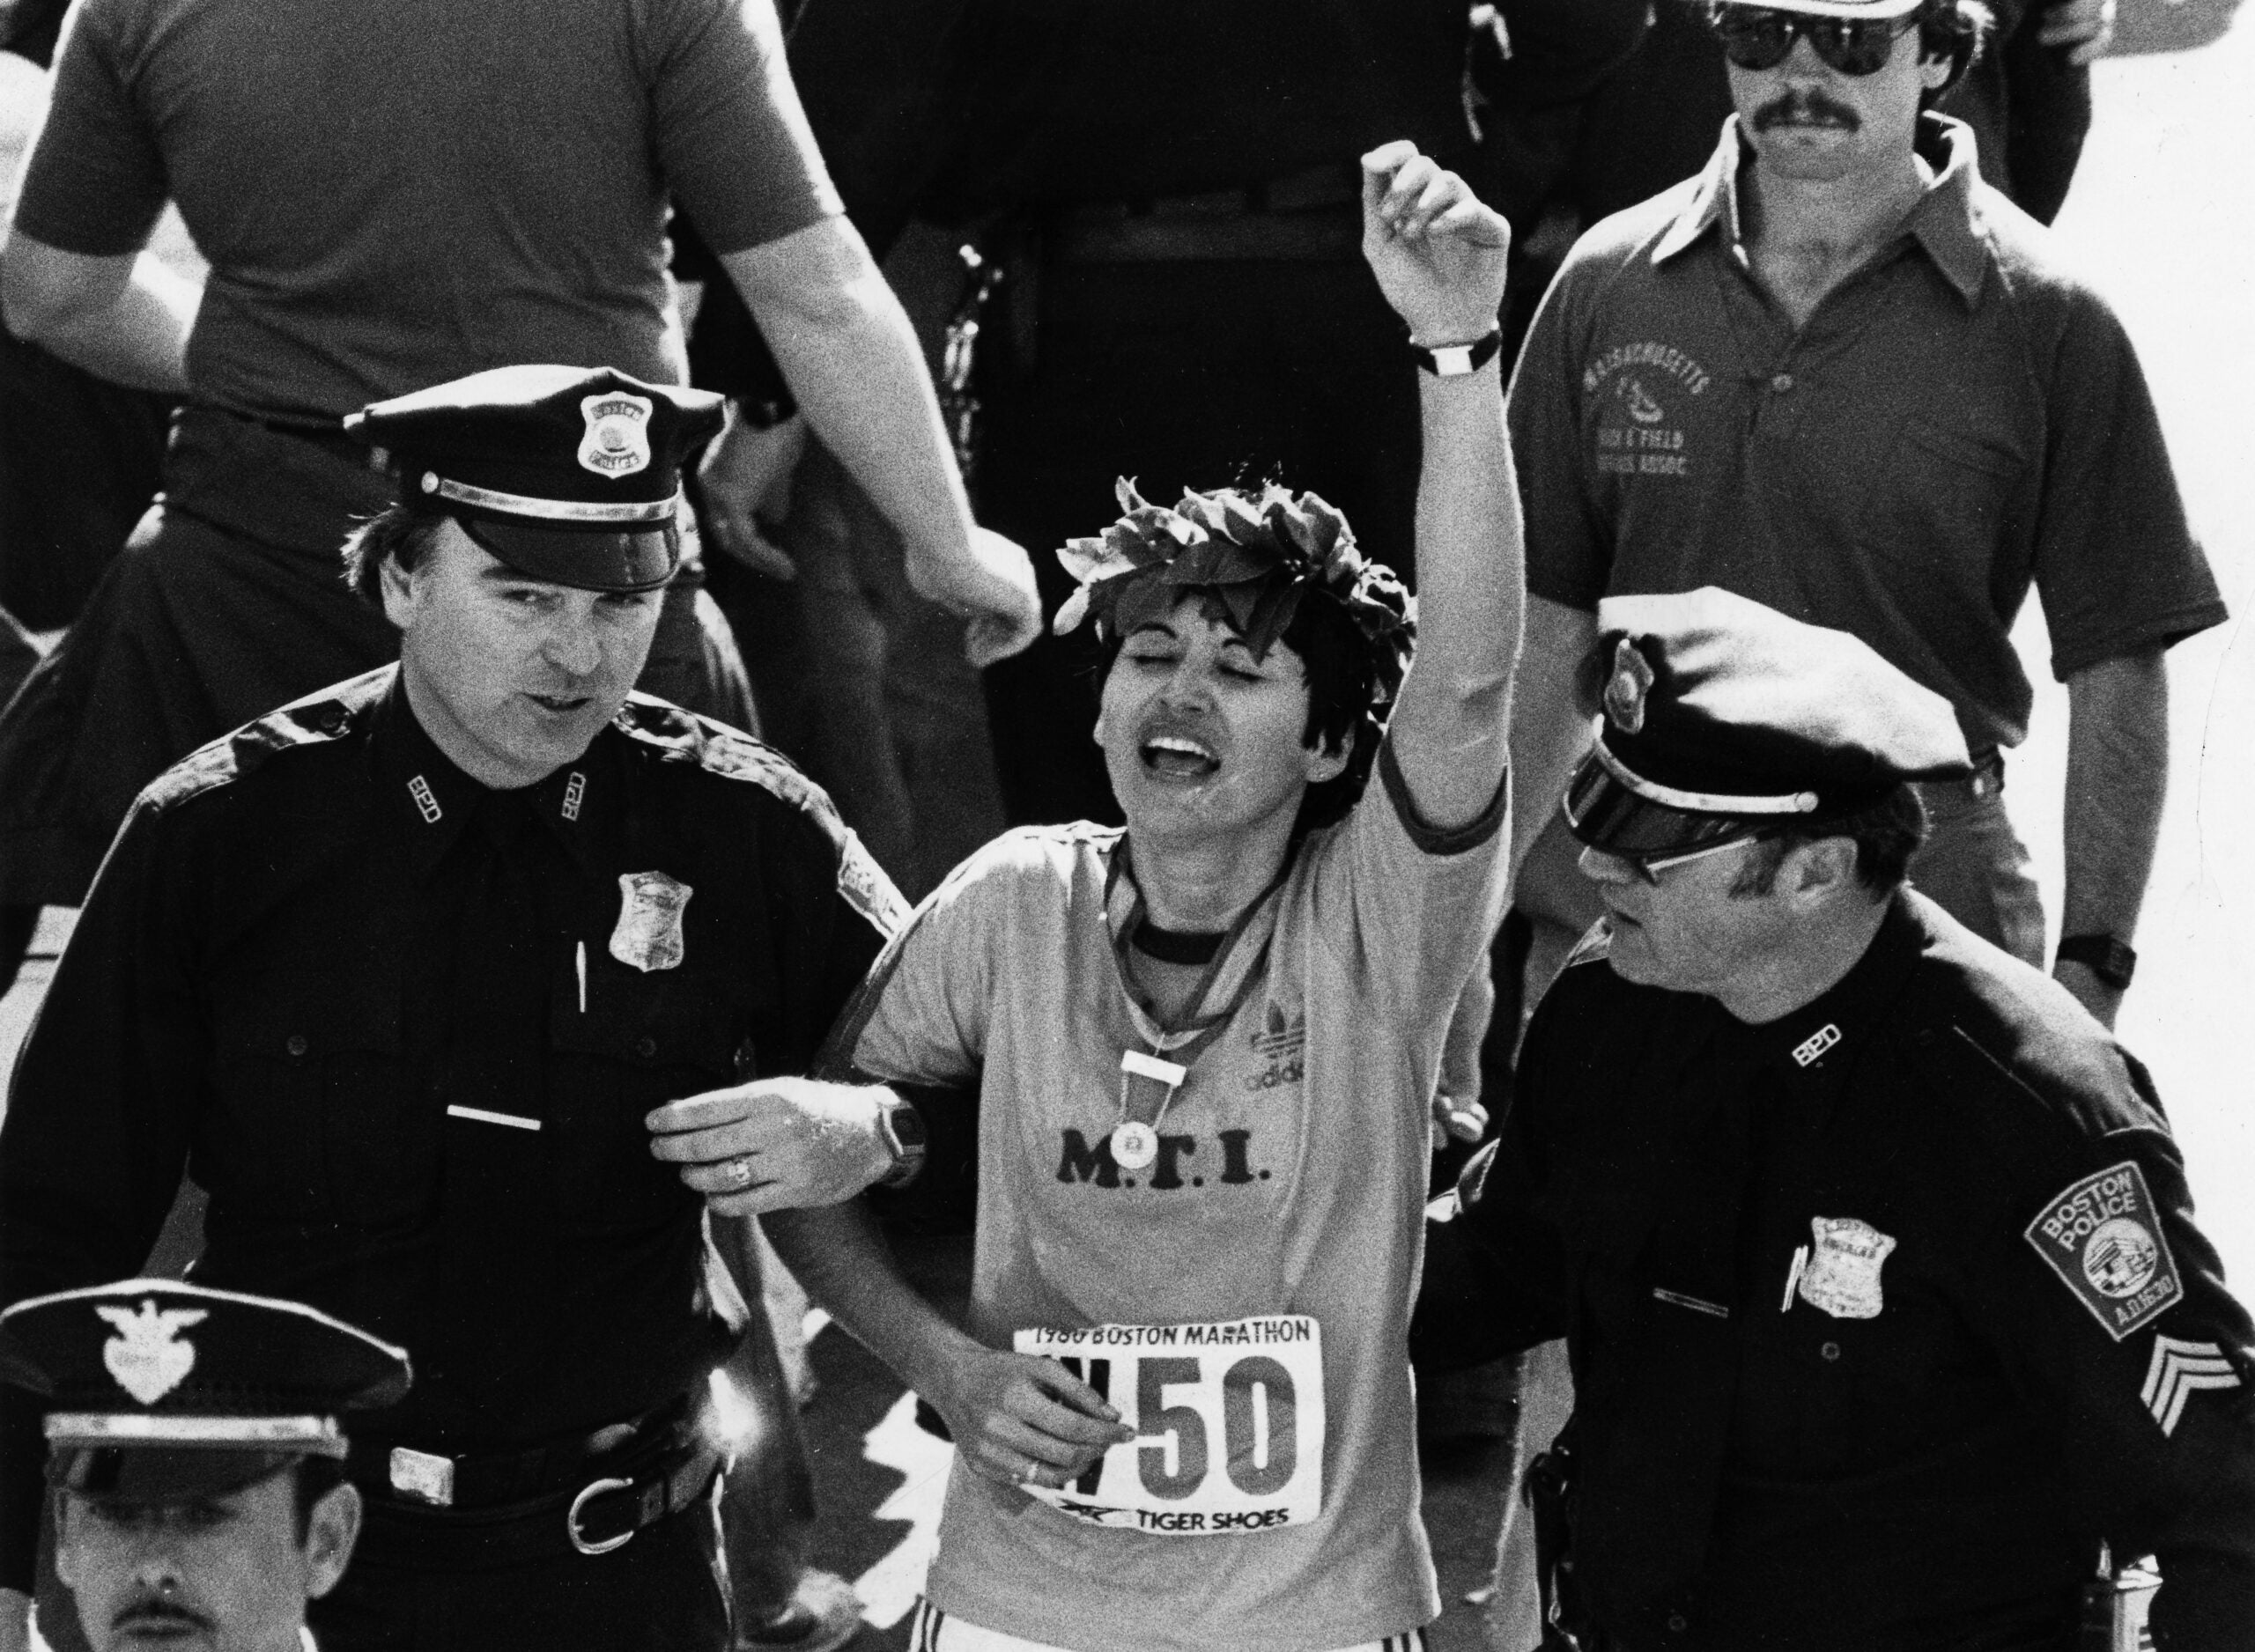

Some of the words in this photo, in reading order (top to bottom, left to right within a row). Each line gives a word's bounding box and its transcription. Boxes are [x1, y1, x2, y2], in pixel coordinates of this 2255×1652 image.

[2041, 1171, 2133, 1238] BOSTON
[2058, 1191, 2138, 1252] POLICE
[1036, 1327, 1090, 1344] 1980
[1091, 1326, 1178, 1346] BOSTON
[1184, 1319, 1311, 1346] MARATHON
[1136, 1508, 1205, 1530] TIGER
[1212, 1508, 1290, 1530] SHOES
